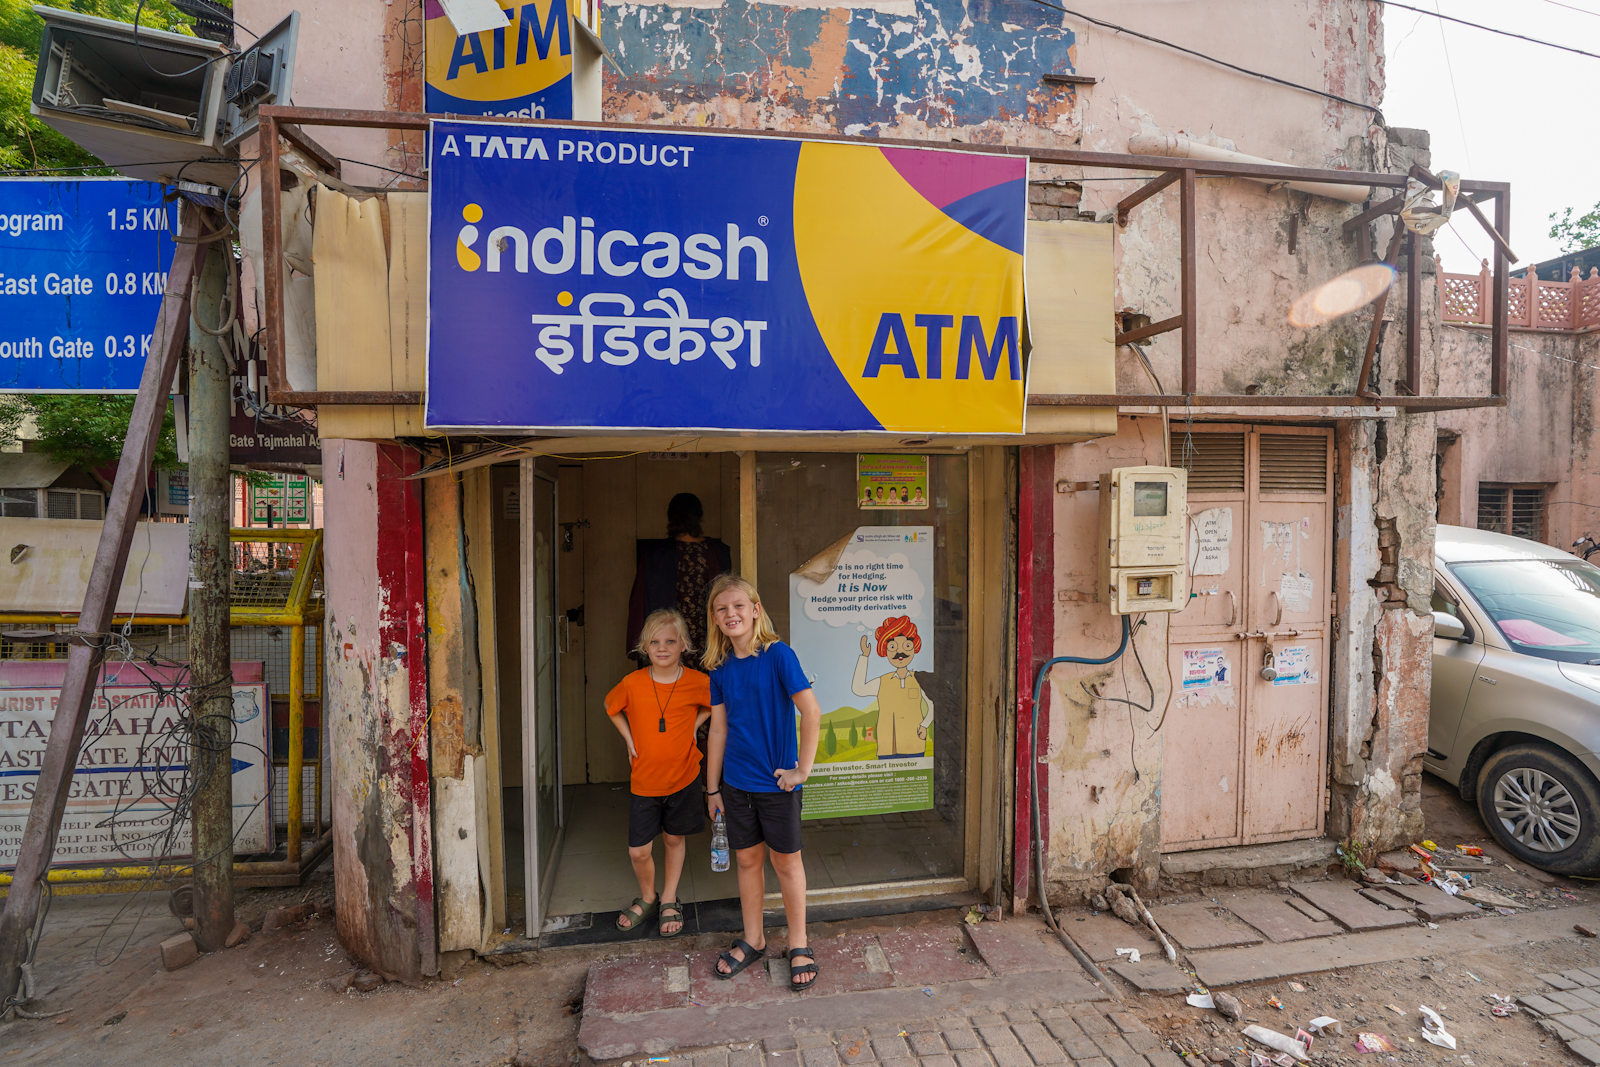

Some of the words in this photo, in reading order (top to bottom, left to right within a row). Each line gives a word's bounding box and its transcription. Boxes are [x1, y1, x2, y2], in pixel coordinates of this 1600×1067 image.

[446, 0, 572, 81] ATM
[441, 134, 460, 156] A
[465, 136, 550, 161] TATA
[557, 139, 694, 167] PRODUCT
[108, 208, 138, 231] 1.5
[143, 208, 169, 231] KM
[456, 203, 769, 282] indicash
[44, 272, 93, 295] Gate
[105, 272, 137, 295] 0.8
[142, 272, 168, 295] KM
[532, 287, 768, 375] इंडिकैश
[49, 335, 94, 359] Gate
[104, 335, 136, 358] 0.3
[140, 334, 153, 358] K
[861, 312, 1022, 381] ATM
[230, 434, 255, 448] Gate
[257, 434, 306, 450] Tajmahal
[866, 562, 884, 573] right
[886, 562, 904, 570] time
[852, 573, 887, 581] Hedging.
[838, 583, 847, 592] It
[849, 583, 860, 592] is
[863, 582, 888, 592] Now
[811, 596, 837, 604] Hedge
[858, 594, 878, 603] price
[880, 593, 895, 601] risk
[896, 593, 913, 601] with
[818, 602, 861, 612] commodity
[864, 602, 907, 610] derivatives
[112, 694, 177, 709] STATION
[83, 716, 191, 737] MAHA
[78, 747, 128, 766] ATE
[832, 764, 864, 772] Investor.
[888, 761, 918, 769] Investor
[69, 778, 132, 798] GATE
[60, 821, 91, 830] HELP
[58, 835, 82, 844] ELP
[86, 833, 118, 843] LINE
[54, 845, 97, 855] OLICE
